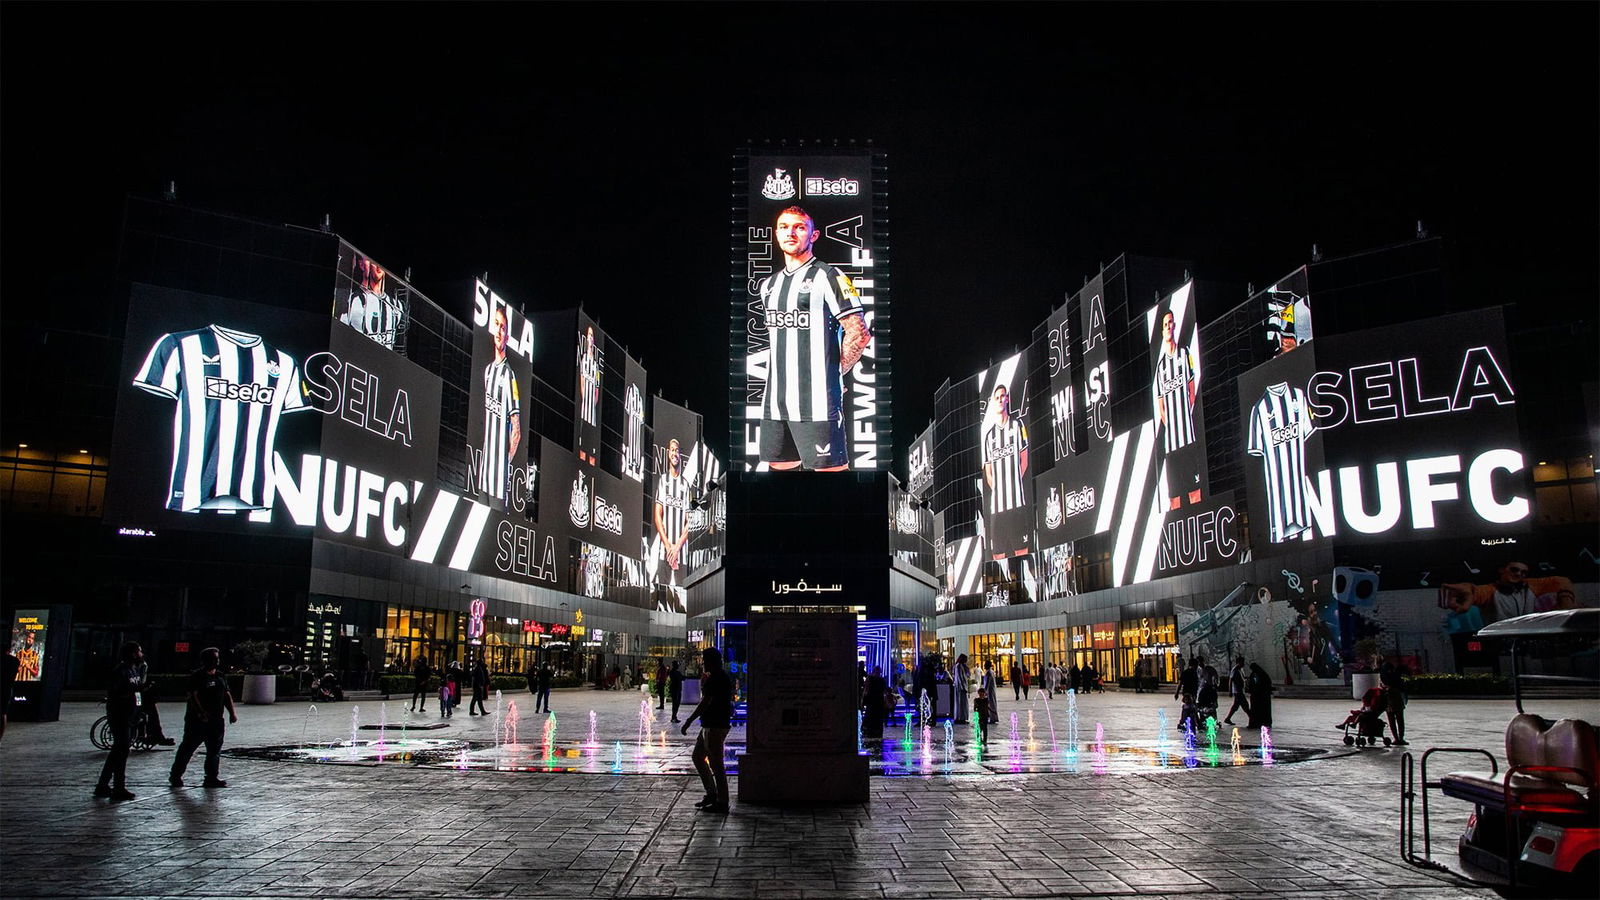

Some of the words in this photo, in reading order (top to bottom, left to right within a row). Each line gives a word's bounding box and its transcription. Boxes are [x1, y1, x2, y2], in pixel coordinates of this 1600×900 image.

[821, 179, 857, 194] sela
[775, 310, 810, 329] sela
[227, 383, 274, 405] sela
[304, 351, 412, 447] SELA
[1307, 346, 1515, 429] SELA
[249, 451, 408, 547] NUFC
[1302, 448, 1530, 541] NUFC
[495, 520, 558, 583] SELA
[1159, 506, 1237, 571] NUFC
[772, 578, 843, 594] سيفورا
